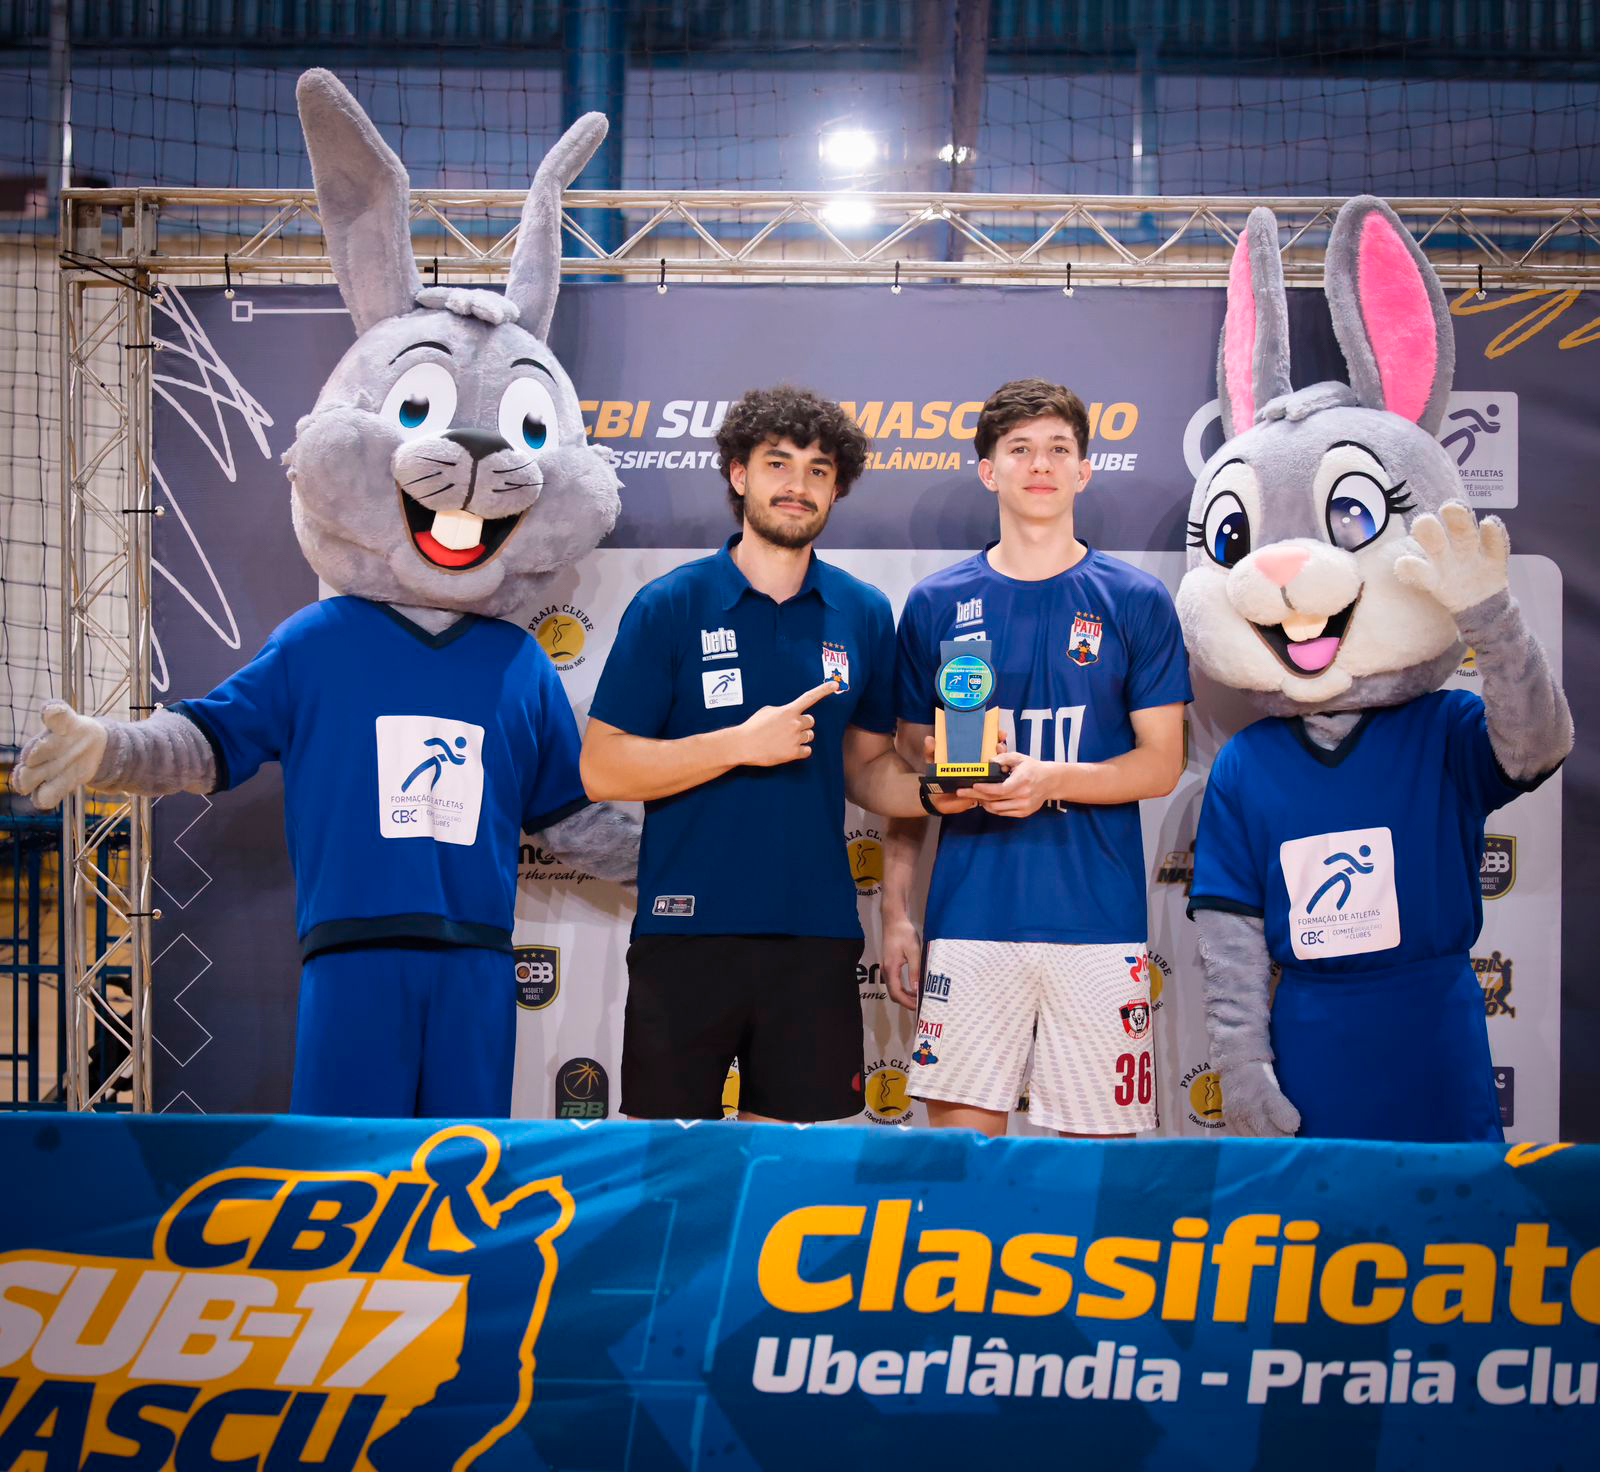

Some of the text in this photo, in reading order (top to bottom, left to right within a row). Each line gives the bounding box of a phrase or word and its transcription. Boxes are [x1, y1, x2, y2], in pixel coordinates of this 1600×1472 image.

[864, 447, 960, 470] RLÂNDIA
[1090, 453, 1138, 471] UBE
[528, 604, 594, 632] PRAIA CLUBE
[1074, 617, 1103, 637] PATO
[701, 627, 737, 655] bets
[574, 656, 586, 668] MG
[391, 809, 417, 823] CBC
[525, 868, 546, 880] the
[548, 869, 577, 880] real
[1298, 914, 1337, 926] FORMAÇÃO
[1350, 909, 1381, 920] ATLETAS
[1300, 930, 1325, 946] CBC
[1147, 951, 1172, 976] LUBE
[860, 991, 888, 1000] ame
[925, 970, 952, 996] bets
[1115, 1051, 1152, 1106] 36
[1180, 1062, 1211, 1088] PRAIA
[901, 1110, 914, 1122] MG
[165, 1180, 430, 1273] CBI
[0, 1260, 464, 1388] SUB-17
[750, 1335, 1181, 1402] Uberlândia
[1247, 1350, 1456, 1404] Praia
[1476, 1346, 1600, 1406] Clu
[0, 1376, 388, 1472] ASCU
